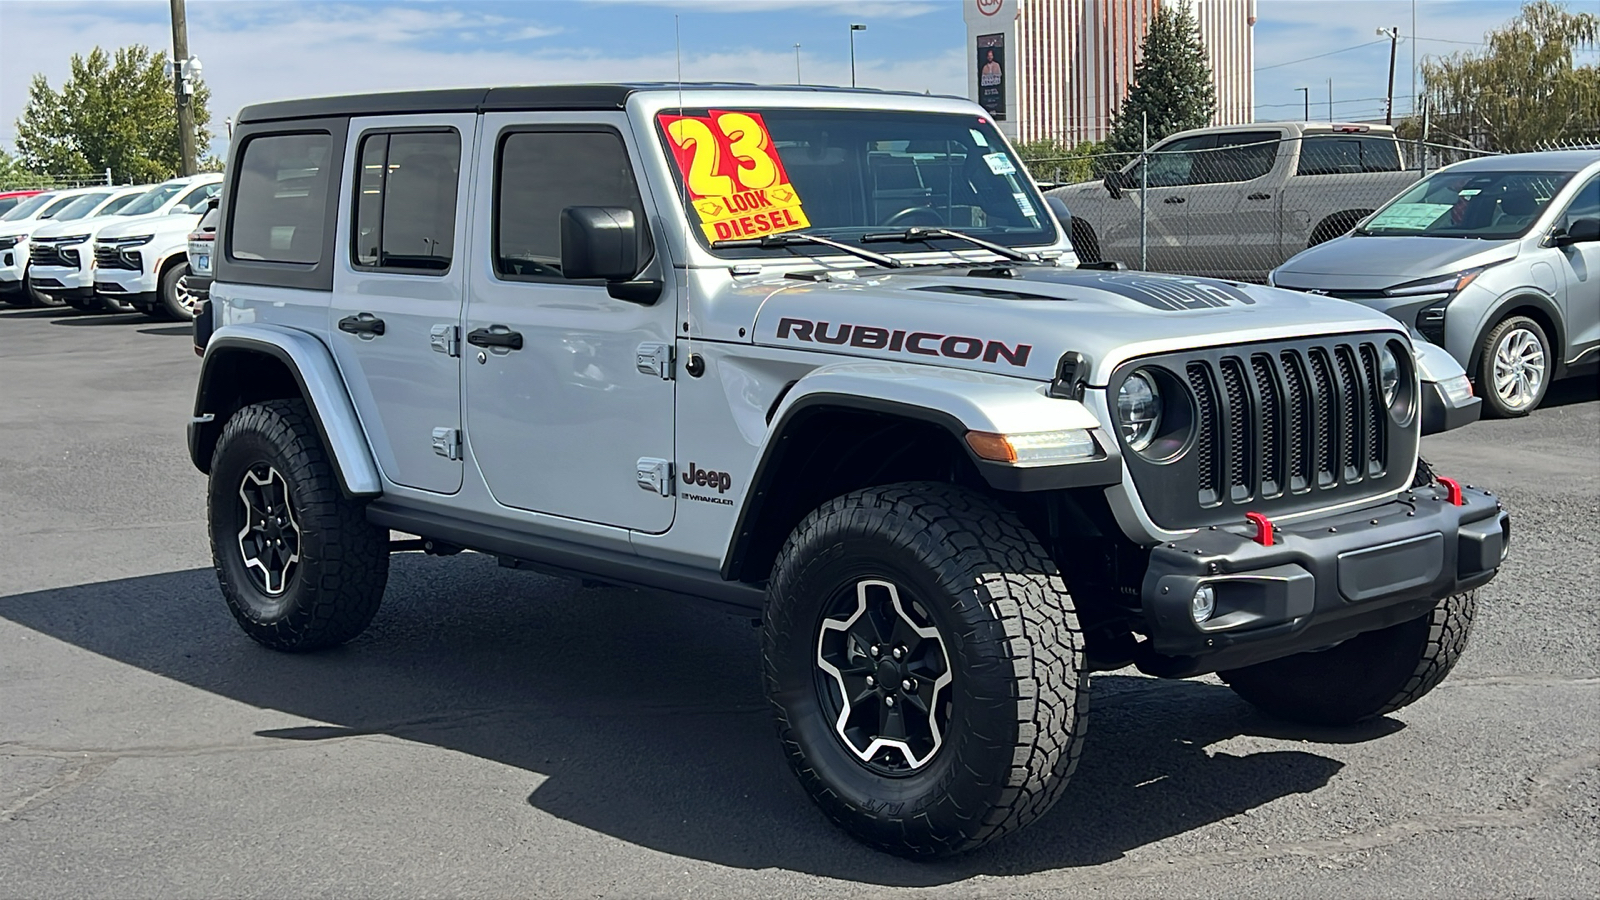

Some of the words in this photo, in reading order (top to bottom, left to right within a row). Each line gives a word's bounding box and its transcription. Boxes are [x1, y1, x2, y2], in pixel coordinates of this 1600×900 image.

[668, 113, 779, 198] 23
[722, 189, 772, 214] LOOK
[713, 209, 800, 240] DIESEL
[776, 317, 1033, 368] RUBICON
[682, 462, 732, 494] Jeep
[689, 493, 734, 506] WRANGLER
